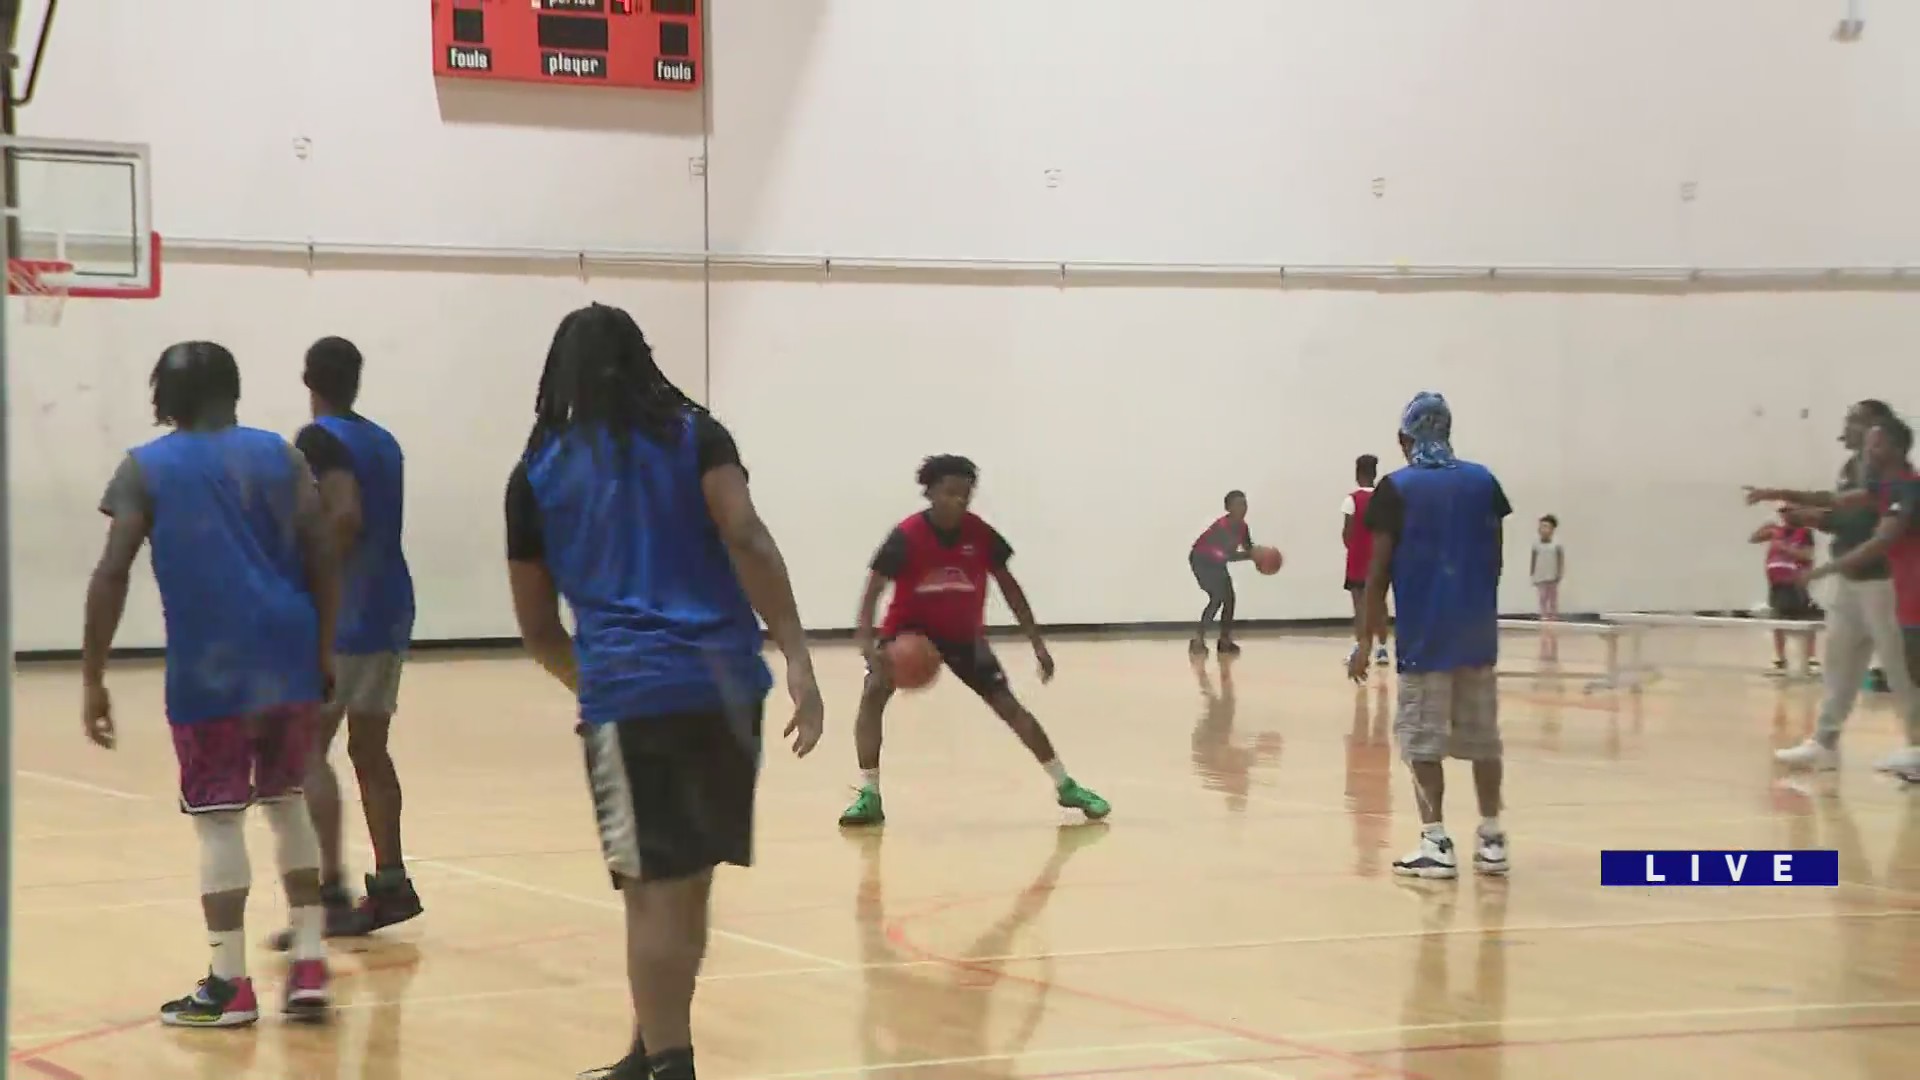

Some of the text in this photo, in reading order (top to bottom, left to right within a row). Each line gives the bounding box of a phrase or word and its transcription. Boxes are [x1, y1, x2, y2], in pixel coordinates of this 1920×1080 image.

[450, 47, 488, 69] fouls
[549, 51, 599, 77] player
[657, 60, 692, 80] fouls
